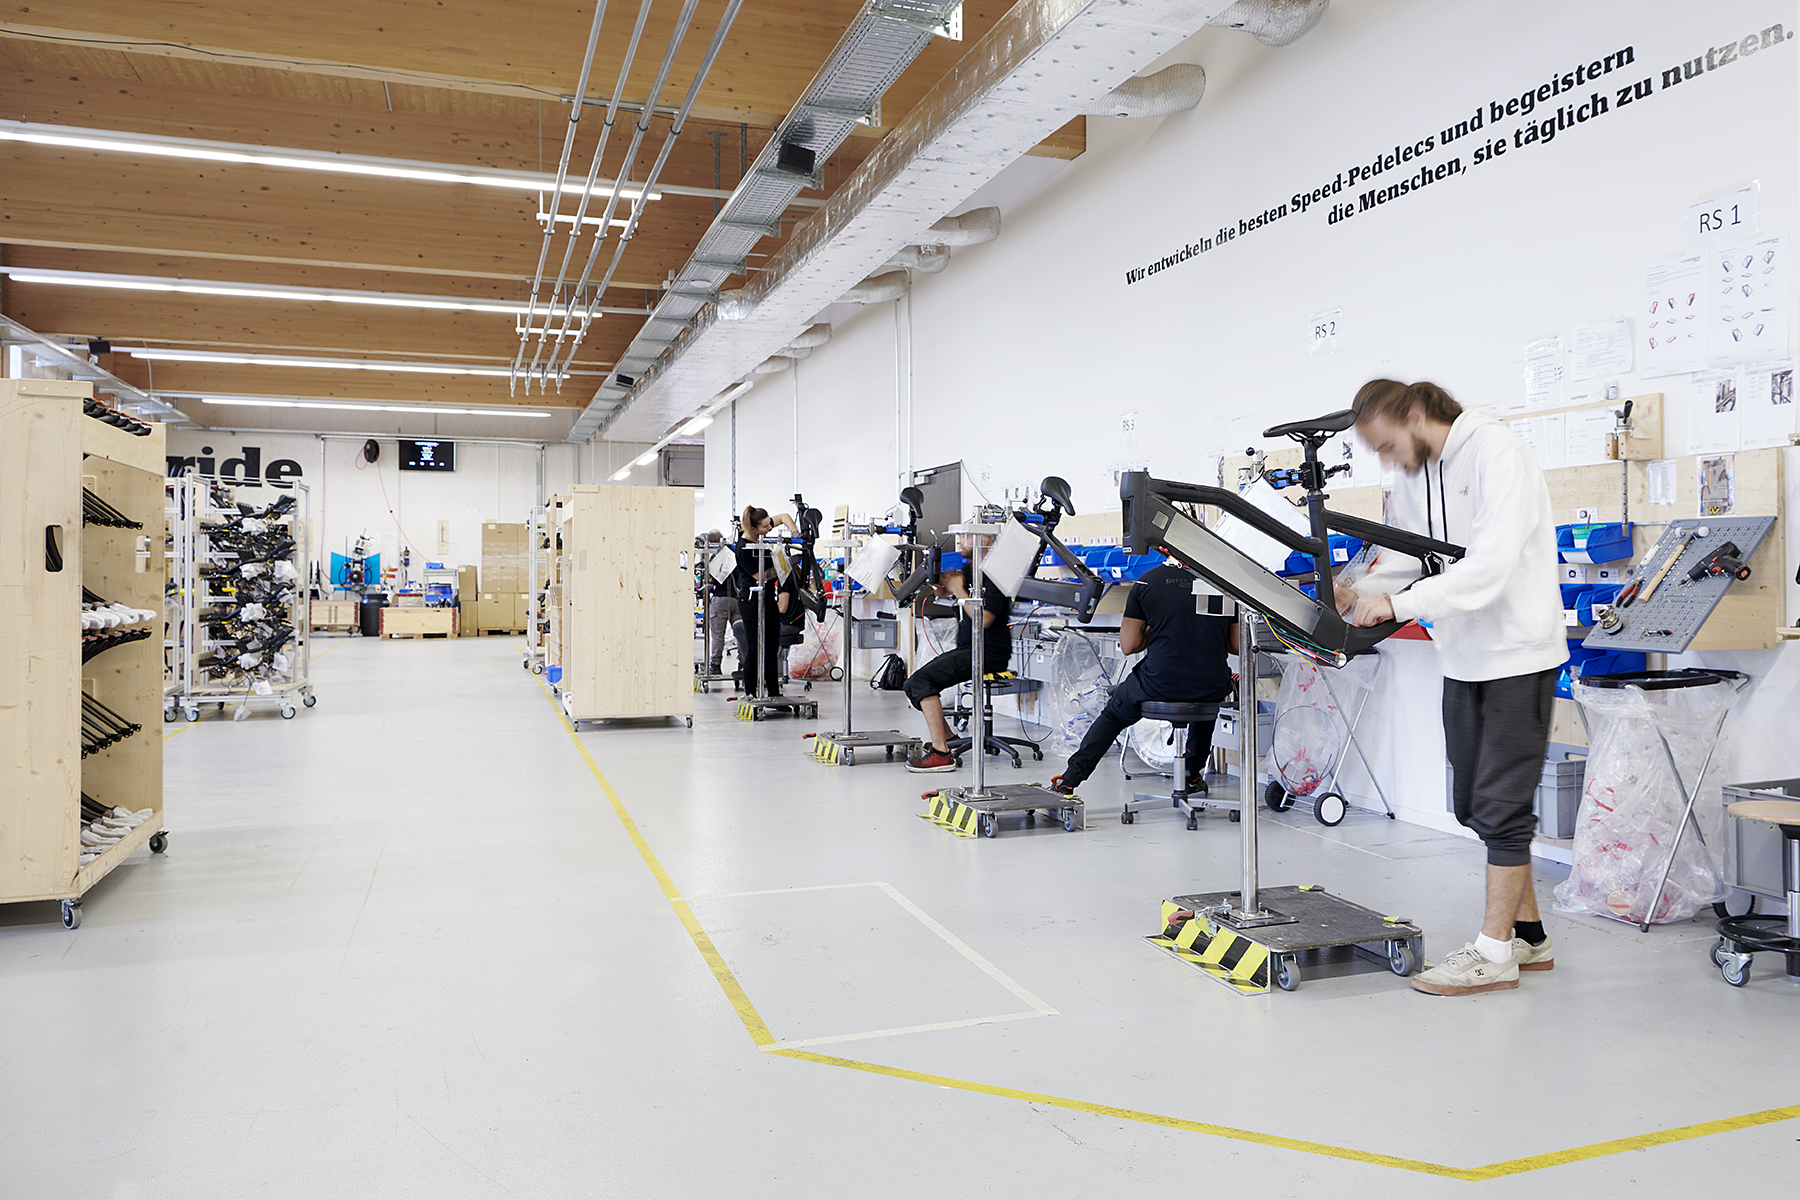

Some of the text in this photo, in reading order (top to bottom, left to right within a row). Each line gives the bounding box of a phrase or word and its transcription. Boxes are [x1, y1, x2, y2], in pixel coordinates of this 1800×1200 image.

[1327, 23, 1795, 226] die Menschen, sie täglich zu nutzen.
[1126, 45, 1635, 285] Wir entwickeln die besten Speed-Pedelecs und begeistern
[1699, 208, 1723, 234] RS
[1730, 204, 1742, 226] 1
[1315, 321, 1336, 340] RS 2
[166, 446, 303, 489] ride
